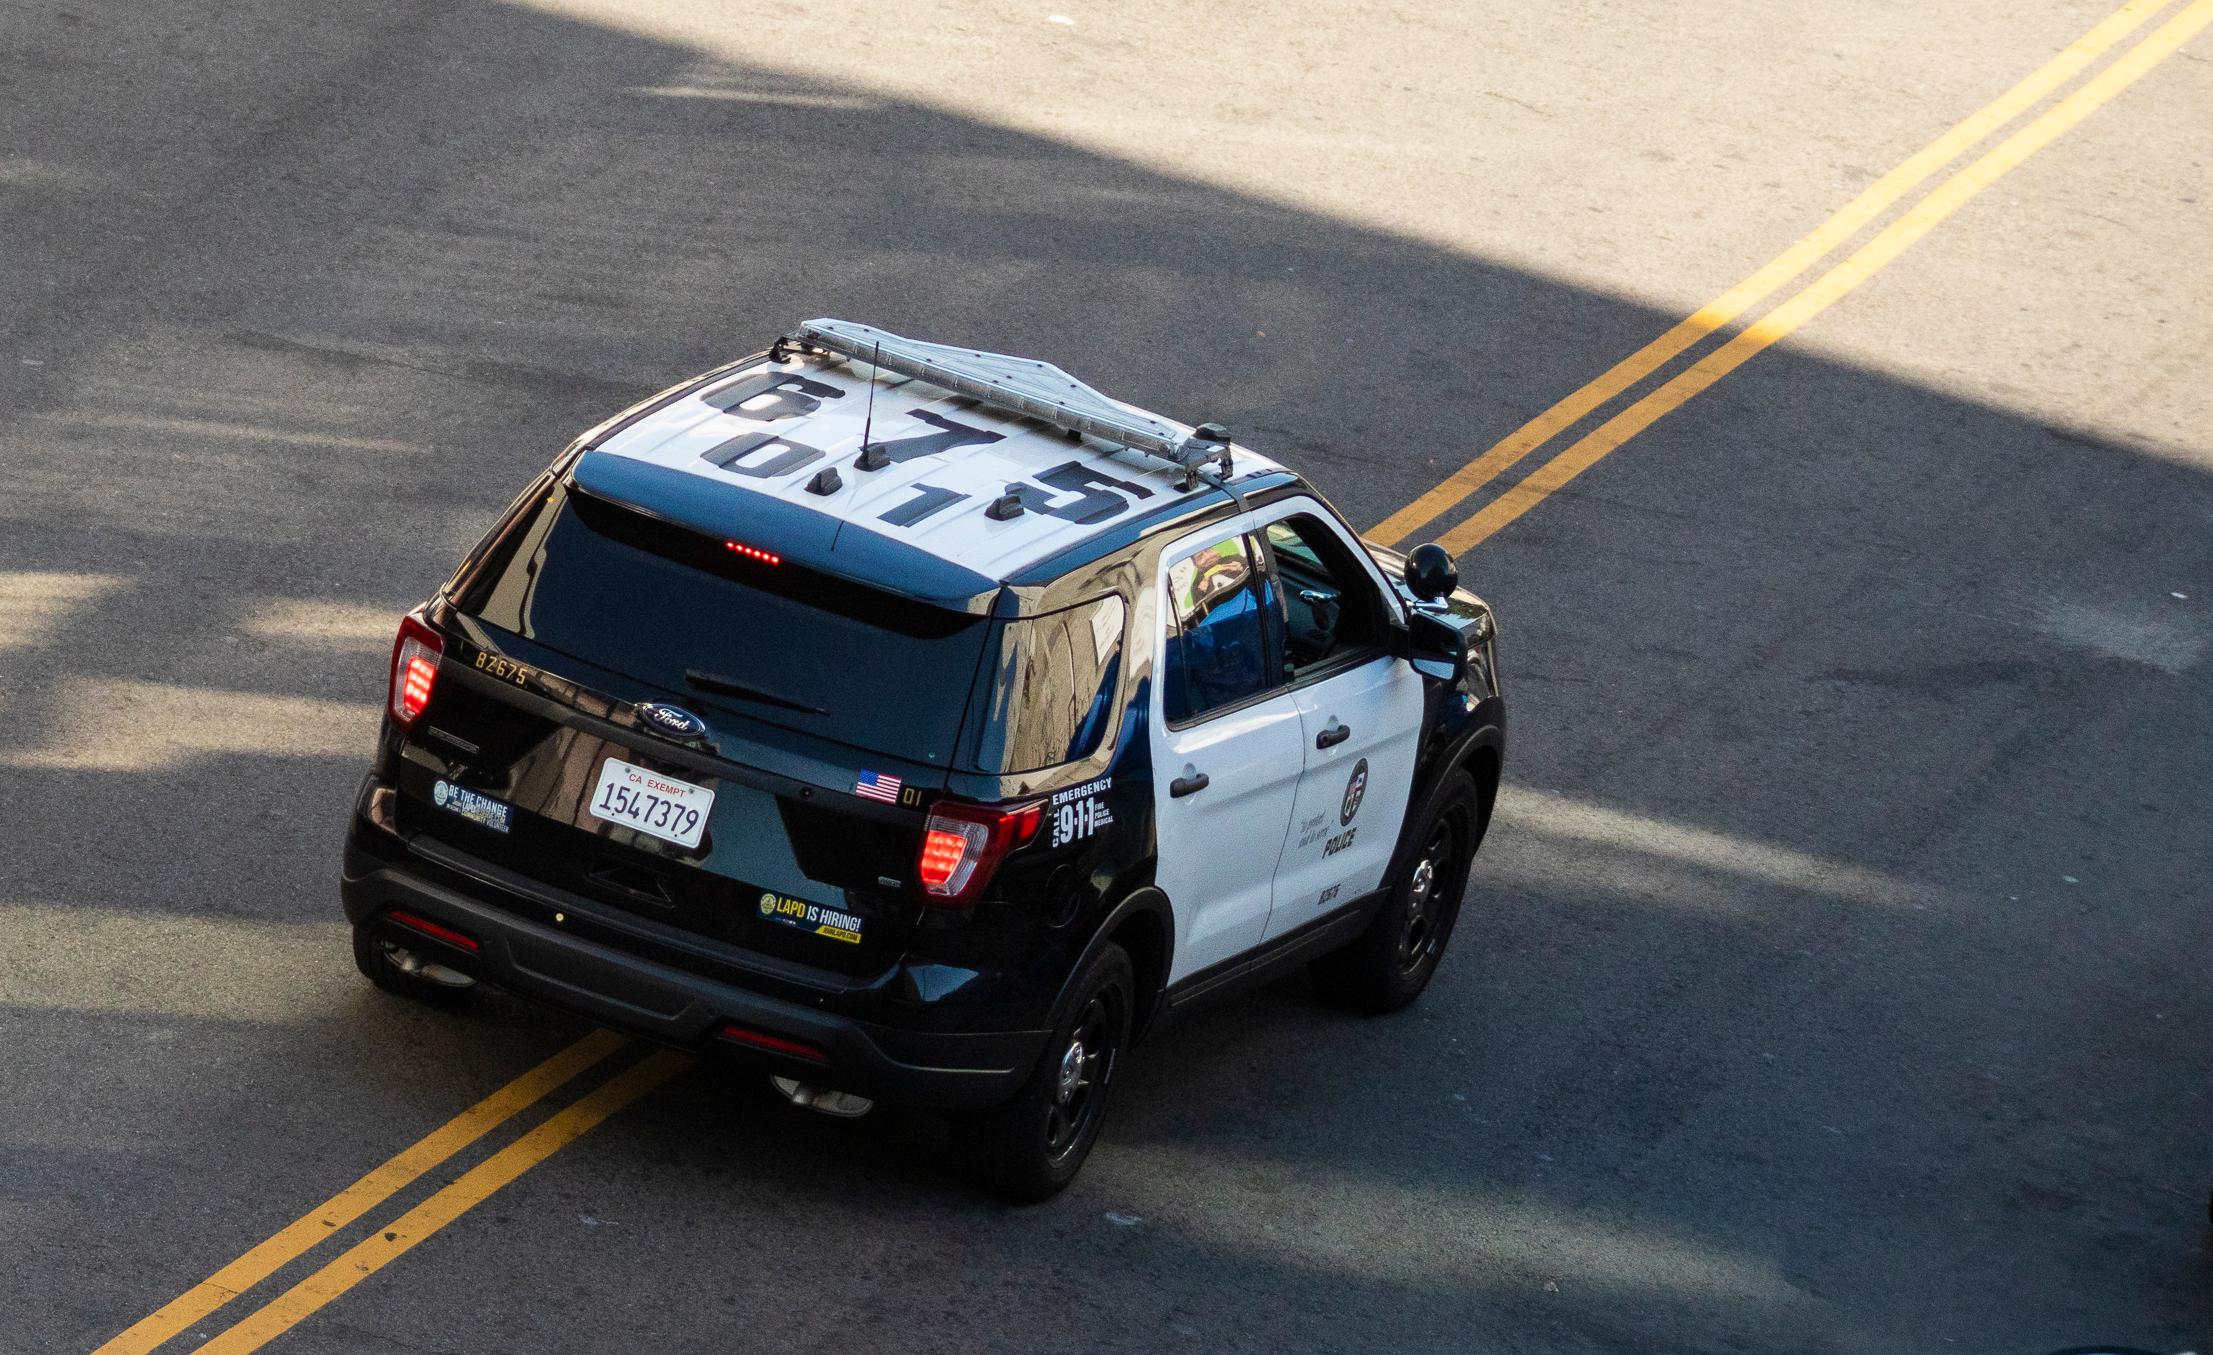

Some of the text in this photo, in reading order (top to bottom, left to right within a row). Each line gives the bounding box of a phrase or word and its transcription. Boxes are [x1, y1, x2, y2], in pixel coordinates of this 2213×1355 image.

[475, 651, 528, 685] 82675
[654, 708, 691, 731] Ford
[628, 773, 686, 798] CA EXEMPT
[903, 787, 922, 807] 01
[1052, 777, 1112, 806] EMERGENCY
[448, 784, 459, 798] BE
[461, 789, 476, 805] THE
[476, 795, 508, 818] CHANGE
[599, 782, 700, 836] 1547379
[1094, 801, 1105, 811] FIRE
[1094, 808, 1110, 819] POLICE
[1052, 808, 1060, 848] CALL
[1094, 815, 1114, 828] MEDICAL
[1321, 826, 1357, 860] POLICE
[776, 897, 806, 919] LAPD
[806, 905, 819, 921] IS
[819, 908, 862, 932] HIRING!
